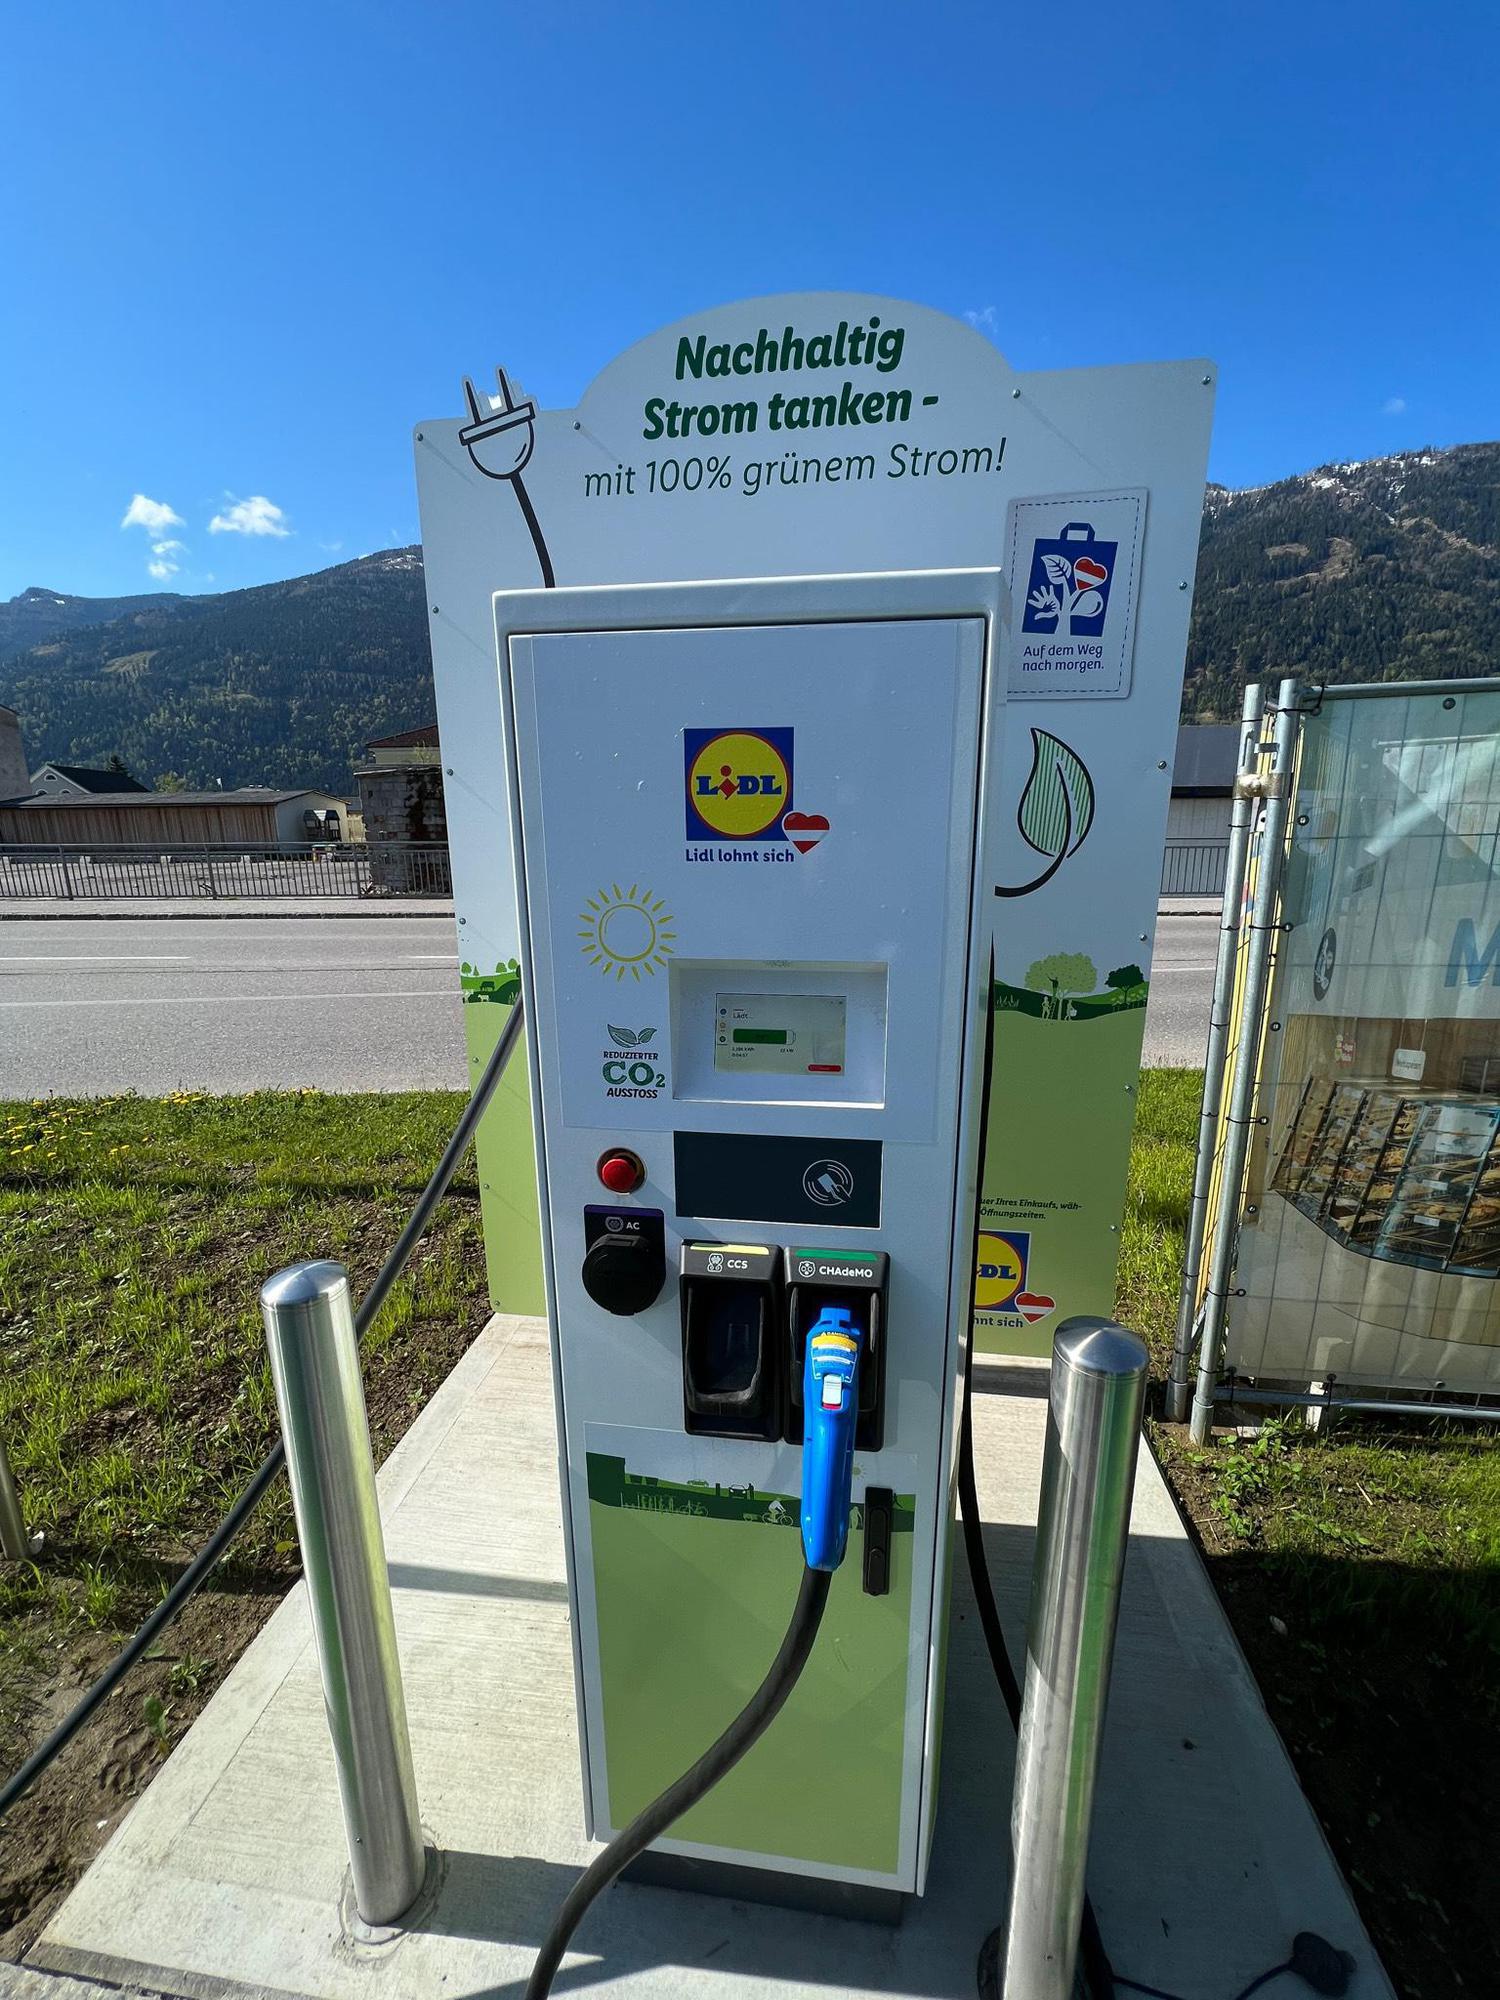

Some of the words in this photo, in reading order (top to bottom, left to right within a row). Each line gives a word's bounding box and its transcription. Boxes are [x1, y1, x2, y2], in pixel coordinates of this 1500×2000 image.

[675, 316, 905, 380] Nachhaltig
[643, 398, 758, 440] Strom
[768, 381, 912, 431] tanken
[584, 463, 636, 497] mit
[646, 455, 732, 492] 100%
[742, 452, 876, 496] grünem
[887, 437, 1007, 479] Strom!
[1023, 644, 1046, 659] Auf
[1048, 644, 1073, 656] dem
[1078, 644, 1103, 658] Weg
[1023, 660, 1051, 671] nach
[1055, 660, 1104, 673] morgen.
[686, 848, 714, 862] Lidl
[718, 848, 759, 862] lohnt
[763, 848, 795, 862] sich
[603, 1051, 659, 1060] REDUZIERTER
[606, 1088, 658, 1099] AUSSTOSS
[995, 1197, 1018, 1206] Ihres
[1019, 1199, 1059, 1210] Einkaufs,
[1060, 1202, 1083, 1210] wäh-
[980, 1207, 1047, 1219] Öffnungszeiten.
[626, 1222, 640, 1230] AC
[727, 1259, 748, 1269] CCS
[818, 1265, 873, 1278] CHAdeMO
[976, 1264, 1017, 1280] DL
[996, 1316, 1024, 1328] sich
